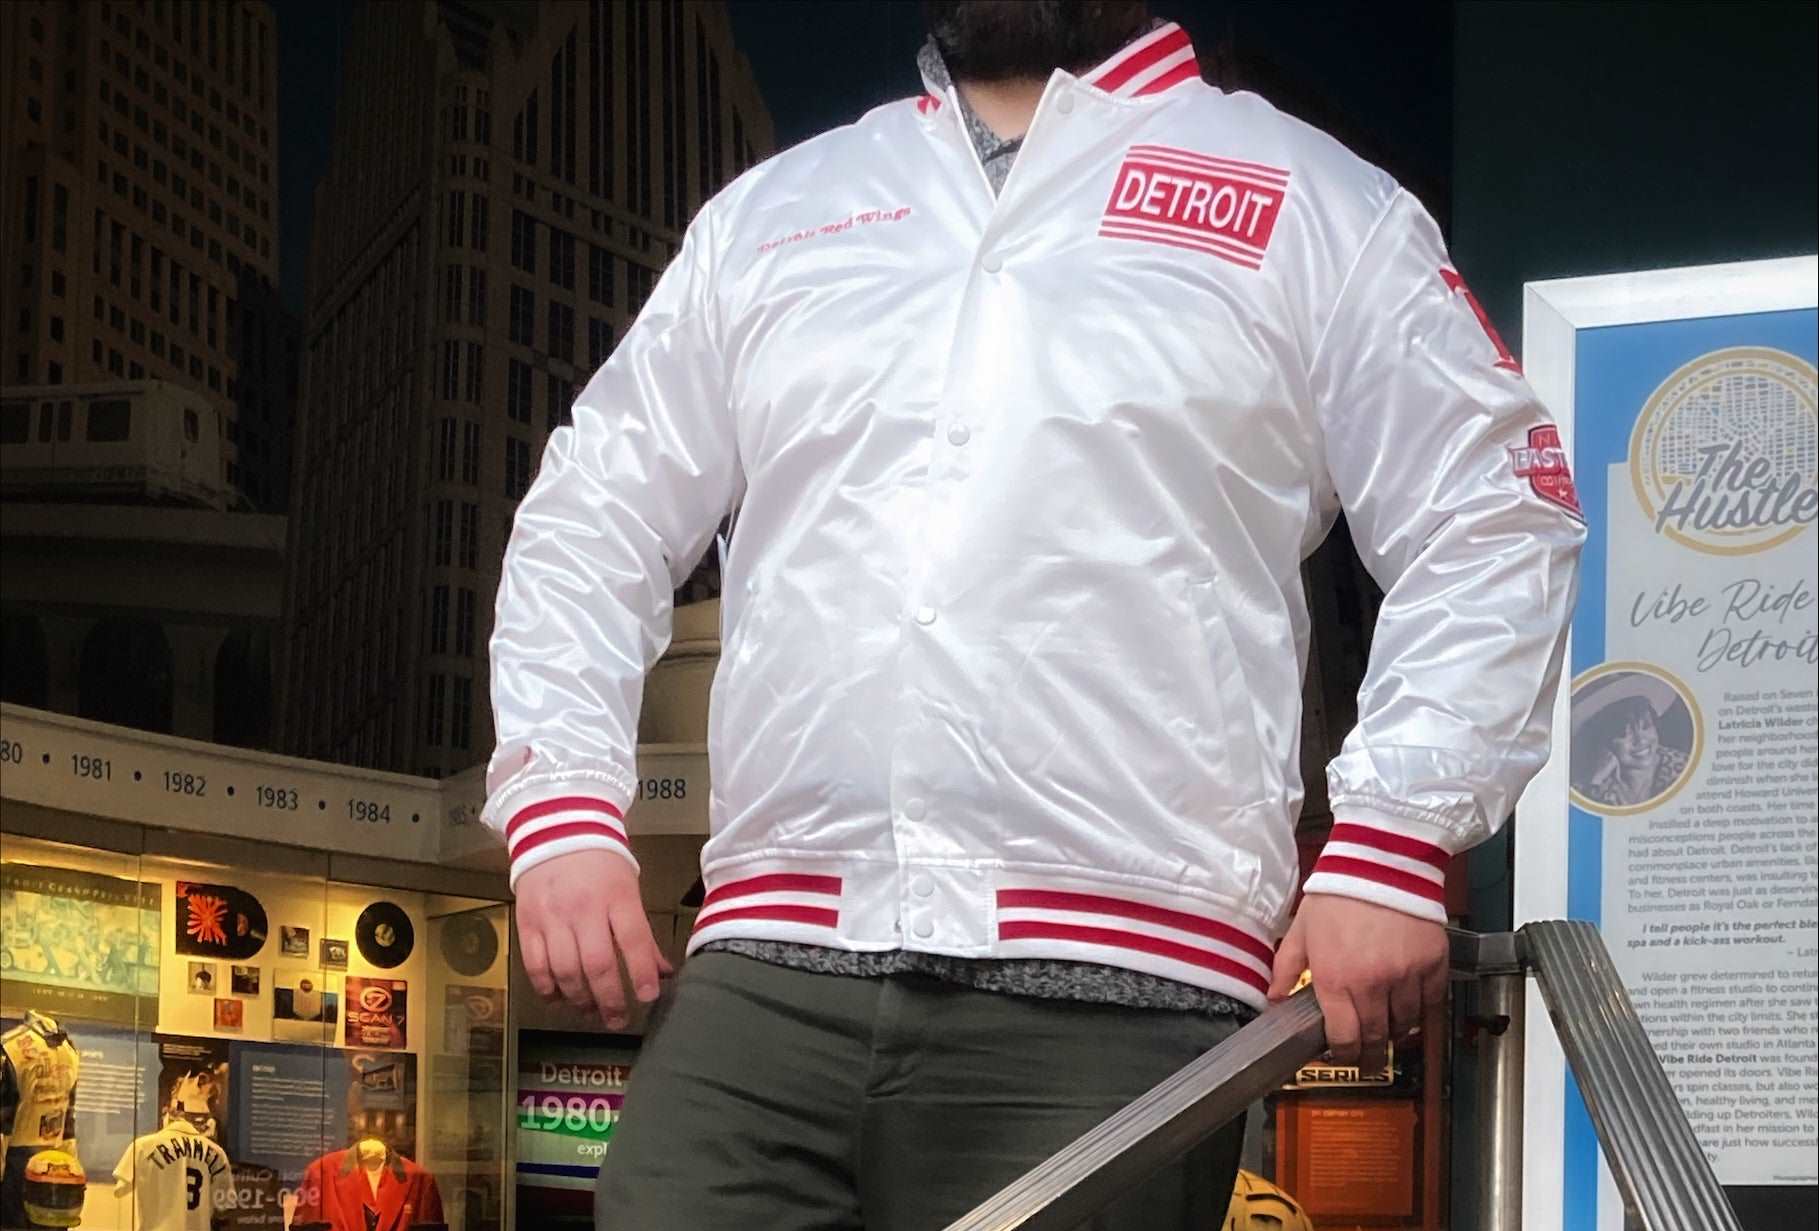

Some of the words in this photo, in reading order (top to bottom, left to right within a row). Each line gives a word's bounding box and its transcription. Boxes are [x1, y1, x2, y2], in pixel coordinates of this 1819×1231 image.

[1115, 168, 1273, 237] DETROIT
[820, 217, 853, 234] Red
[855, 207, 912, 225] Wings
[1694, 439, 1771, 493] The
[1655, 471, 1818, 534] Hustle
[1630, 583, 1711, 628] Vibe
[1721, 578, 1814, 624] Ride
[1719, 719, 1762, 730] Latricia
[1764, 717, 1804, 729] Wilder
[1757, 761, 1775, 769] the
[1777, 759, 1798, 770] city
[71, 754, 112, 782] 1981
[163, 771, 207, 797] 1982
[255, 784, 299, 811] 1983
[348, 799, 391, 824] 1984
[638, 778, 687, 801] 1988
[1734, 788, 1779, 799] Howard
[1680, 806, 1695, 815] on
[1697, 804, 1724, 814] both
[1767, 802, 1787, 811] Her
[1702, 818, 1730, 829] deep
[1733, 816, 1793, 827] motivation
[1795, 815, 1809, 824] to
[1628, 832, 1715, 845] misconceptions
[1718, 831, 1756, 843] people
[1759, 830, 1794, 839] across
[1797, 828, 1816, 838] the
[1628, 848, 1649, 858] had
[1651, 847, 1683, 857] about
[1730, 844, 1777, 855] Detroit's
[1780, 843, 1802, 853] lack
[1628, 860, 1707, 873] commonplace
[1710, 859, 1743, 869] urban
[1628, 875, 1649, 886] and
[1651, 873, 1687, 884] fitness
[1736, 873, 1757, 882] was
[1760, 871, 1808, 882] insulting
[1628, 889, 1642, 899] To
[1667, 887, 1706, 898] Detroit
[1708, 888, 1730, 897] was
[1732, 886, 1753, 898] just
[1755, 887, 1767, 895] as
[1627, 902, 1686, 913] businesses
[1688, 903, 1701, 911] as
[1703, 900, 1734, 912] Royal
[1736, 899, 1759, 910] Oak
[1761, 901, 1774, 909] or
[1650, 923, 1668, 933] tell
[1670, 922, 1711, 934] people
[1713, 921, 1729, 932] it's
[1732, 921, 1750, 931] the
[1753, 920, 1797, 932] perfect
[1627, 939, 1646, 949] spa
[1650, 937, 1672, 946] and
[1683, 935, 1731, 946] kick-ass
[1733, 935, 1786, 945] workout.
[1641, 971, 1677, 982] Wilder
[1680, 973, 1707, 983] grew
[1710, 970, 1775, 981] determined
[1777, 970, 1790, 979] to
[1792, 969, 1818, 979] retur
[1628, 986, 1648, 996] and
[1650, 987, 1679, 997] open
[1690, 984, 1727, 995] fitness
[1729, 983, 1763, 994] studio
[1765, 984, 1778, 993] to
[1653, 999, 1689, 1009] health
[1691, 999, 1736, 1010] regimen
[1738, 998, 1764, 1008] after
[1768, 998, 1787, 1007] she
[1790, 999, 1812, 1007] saw
[347, 1011, 393, 1026] SCAN
[1641, 1013, 1668, 1023] tions
[1670, 1012, 1705, 1022] within
[1707, 1012, 1725, 1022] the
[1728, 1011, 1748, 1023] city
[1786, 1010, 1807, 1020] She
[1691, 1026, 1715, 1036] with
[1718, 1027, 1740, 1036] two
[1743, 1025, 1780, 1035] friends
[1783, 1024, 1808, 1034] who
[1670, 1039, 1697, 1050] their
[1699, 1041, 1724, 1050] own
[1726, 1038, 1760, 1049] studio
[1776, 1038, 1816, 1049] Atlanta
[1659, 1054, 1684, 1064] Vibe
[1687, 1054, 1713, 1064] Ride
[1716, 1053, 1757, 1063] Detroit
[1760, 1054, 1781, 1063] was
[1784, 1053, 1818, 1063] found
[541, 1063, 624, 1087] Detroit
[1679, 1068, 1721, 1079] opened
[1723, 1068, 1737, 1077] its
[1777, 1067, 1802, 1076] Vibe
[1687, 1082, 1710, 1093] spin
[1756, 1082, 1775, 1091] but
[1778, 1081, 1800, 1091] also
[1696, 1096, 1736, 1107] healthy
[1774, 1096, 1795, 1105] and
[1687, 1110, 1714, 1121] lding
[1717, 1111, 1731, 1121] up
[1736, 1124, 1754, 1133] her
[1757, 1124, 1800, 1133] mission
[1803, 1124, 1815, 1132] to
[577, 1142, 608, 1159] expl
[1721, 1138, 1741, 1149] just
[1745, 1138, 1769, 1147] how
